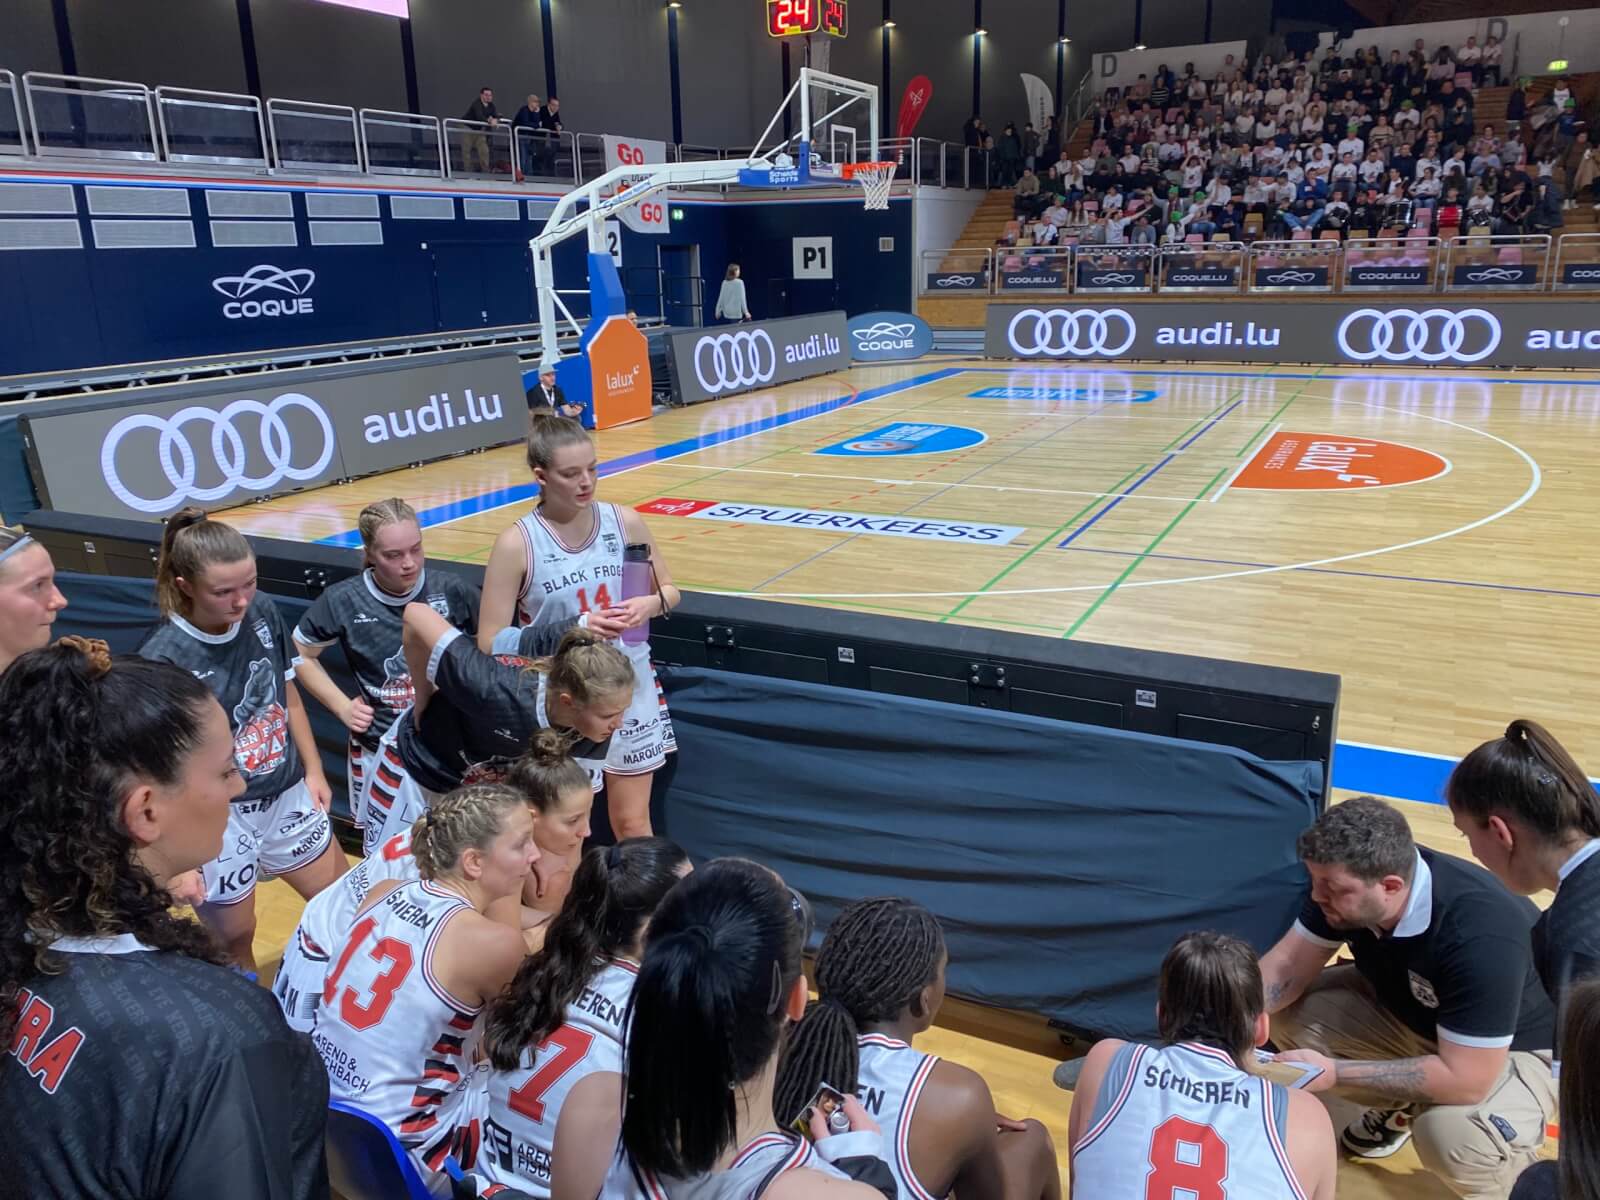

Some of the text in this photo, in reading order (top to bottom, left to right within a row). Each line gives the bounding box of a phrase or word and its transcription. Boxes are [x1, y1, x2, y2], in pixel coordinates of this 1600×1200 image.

[777, 0, 809, 28] 24
[825, 0, 843, 28] 24
[1101, 54, 1117, 77] D
[641, 203, 662, 223] GO
[608, 231, 619, 257] 2
[803, 246, 826, 270] P1
[223, 298, 314, 319] COQUE
[784, 332, 840, 363] audi.lu
[858, 340, 915, 351] COQUE
[1156, 322, 1280, 346] audi.lu
[606, 371, 634, 390] lalux
[363, 389, 503, 443] audi.lu
[708, 506, 1005, 541] SPUERKEESS
[542, 570, 588, 594] BLACK
[576, 583, 611, 614] 14
[620, 718, 659, 736] DHIKA
[219, 863, 256, 895] KO
[323, 915, 415, 1032] 13
[315, 1033, 357, 1072] AREND &
[508, 1022, 596, 1125] 7
[1144, 1065, 1250, 1109] SCHIEREN
[1144, 1113, 1229, 1200] 8
